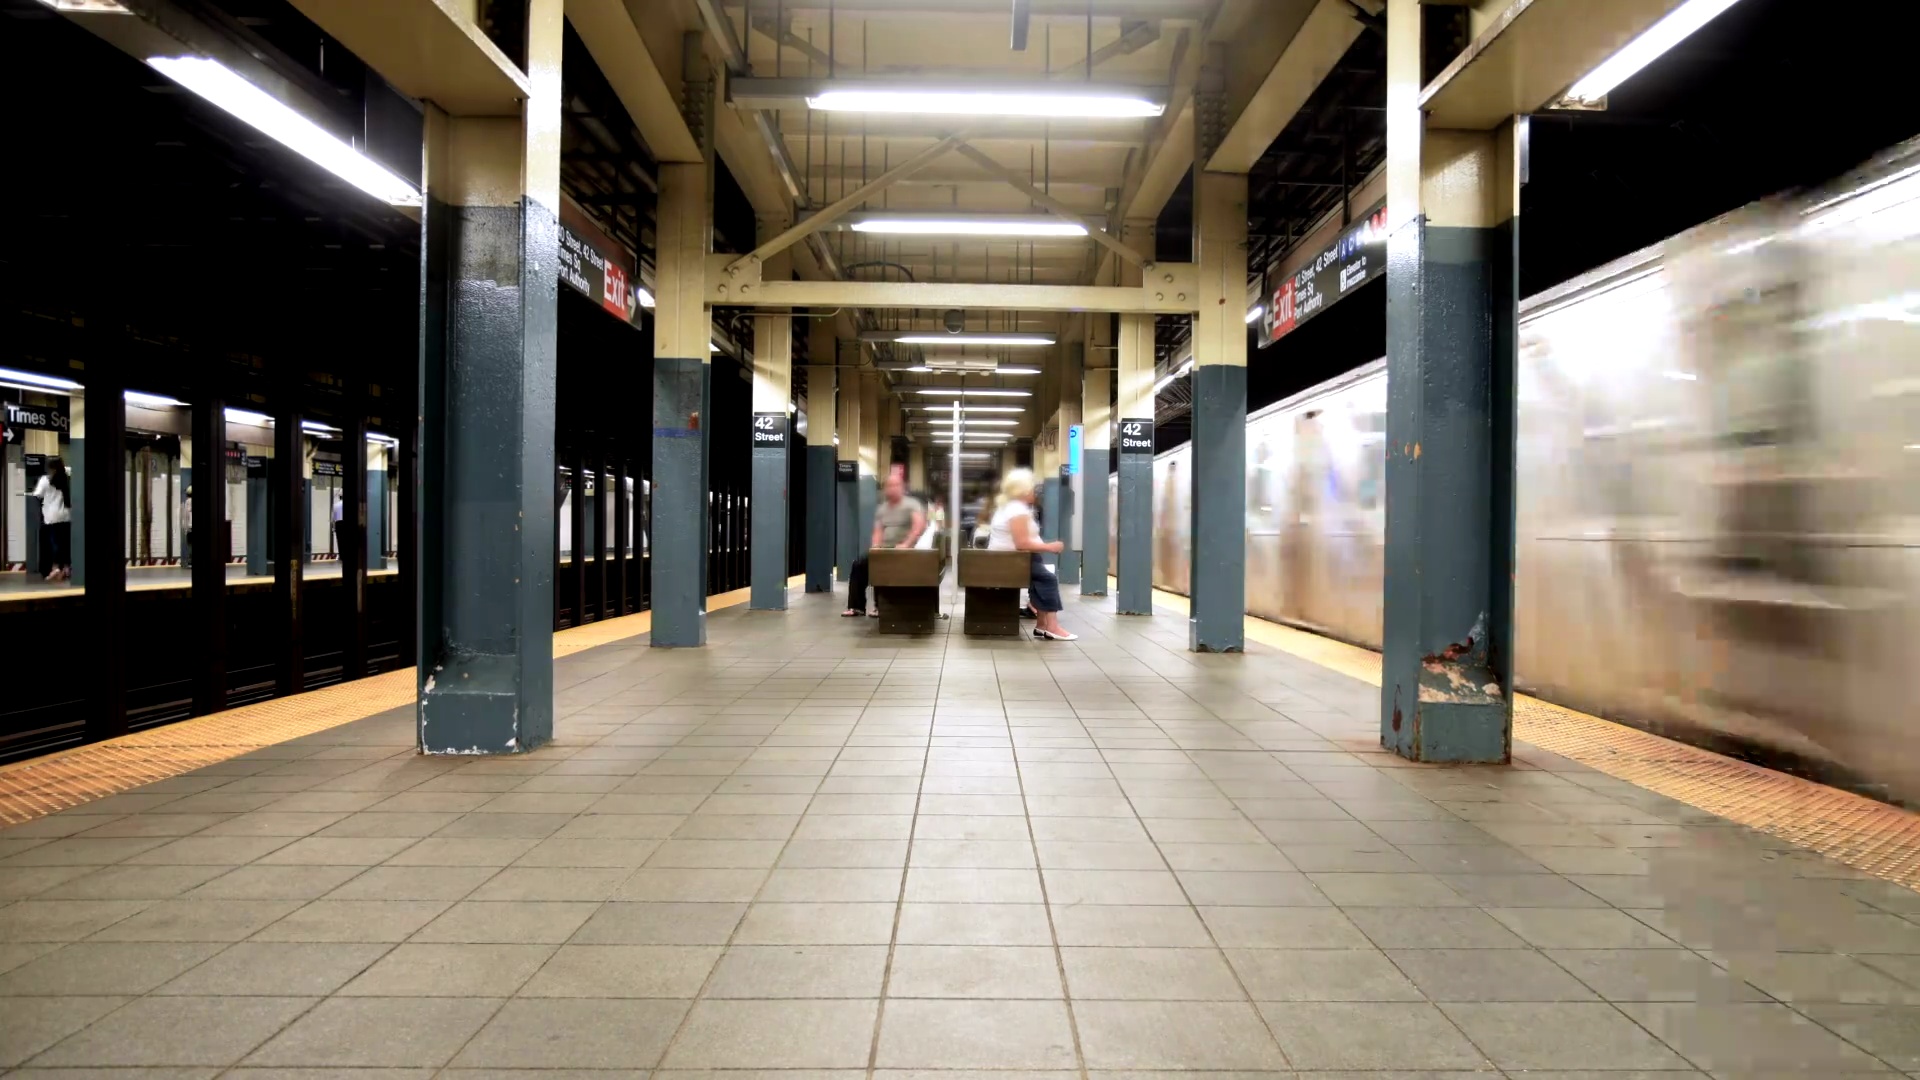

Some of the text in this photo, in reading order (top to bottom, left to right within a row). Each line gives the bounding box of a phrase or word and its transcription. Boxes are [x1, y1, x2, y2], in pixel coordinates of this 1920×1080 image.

[573, 253, 581, 274] Sq
[583, 244, 590, 260] 42
[590, 248, 604, 271] Street
[1316, 256, 1322, 273] 42
[1323, 244, 1338, 268] Street
[569, 267, 590, 296] Authority
[604, 258, 625, 311] Exit
[1307, 281, 1313, 297] Sq
[1273, 282, 1292, 329] Exit
[1303, 292, 1322, 314] Authority
[7, 405, 46, 425] Times
[755, 417, 774, 430] 42
[755, 432, 784, 441] Street
[1122, 424, 1141, 436] 42
[1122, 438, 1151, 448] Street
